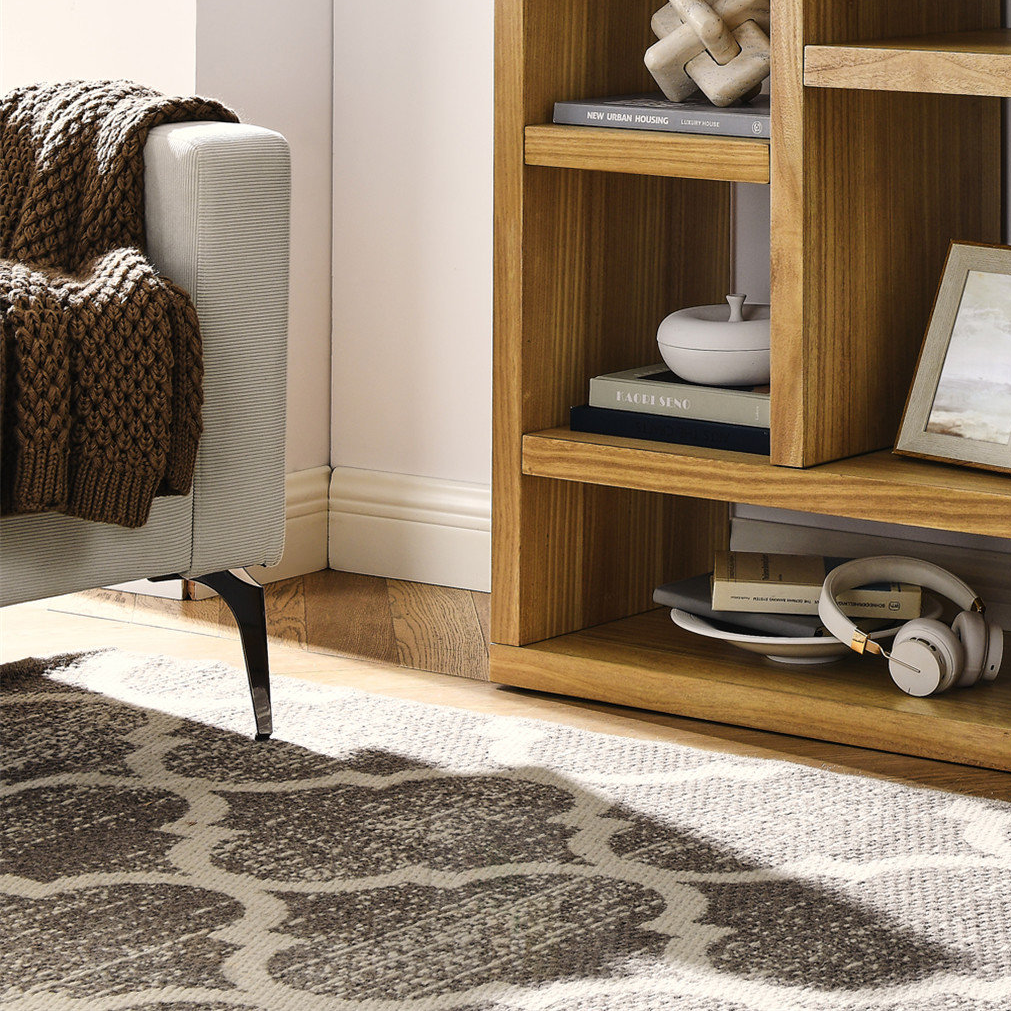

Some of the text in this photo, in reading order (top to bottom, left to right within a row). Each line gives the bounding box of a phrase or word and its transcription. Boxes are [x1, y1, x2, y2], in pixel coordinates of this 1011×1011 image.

[586, 111, 669, 125] NEW URBAN HOUSING
[616, 391, 691, 410] KAORI SENO
